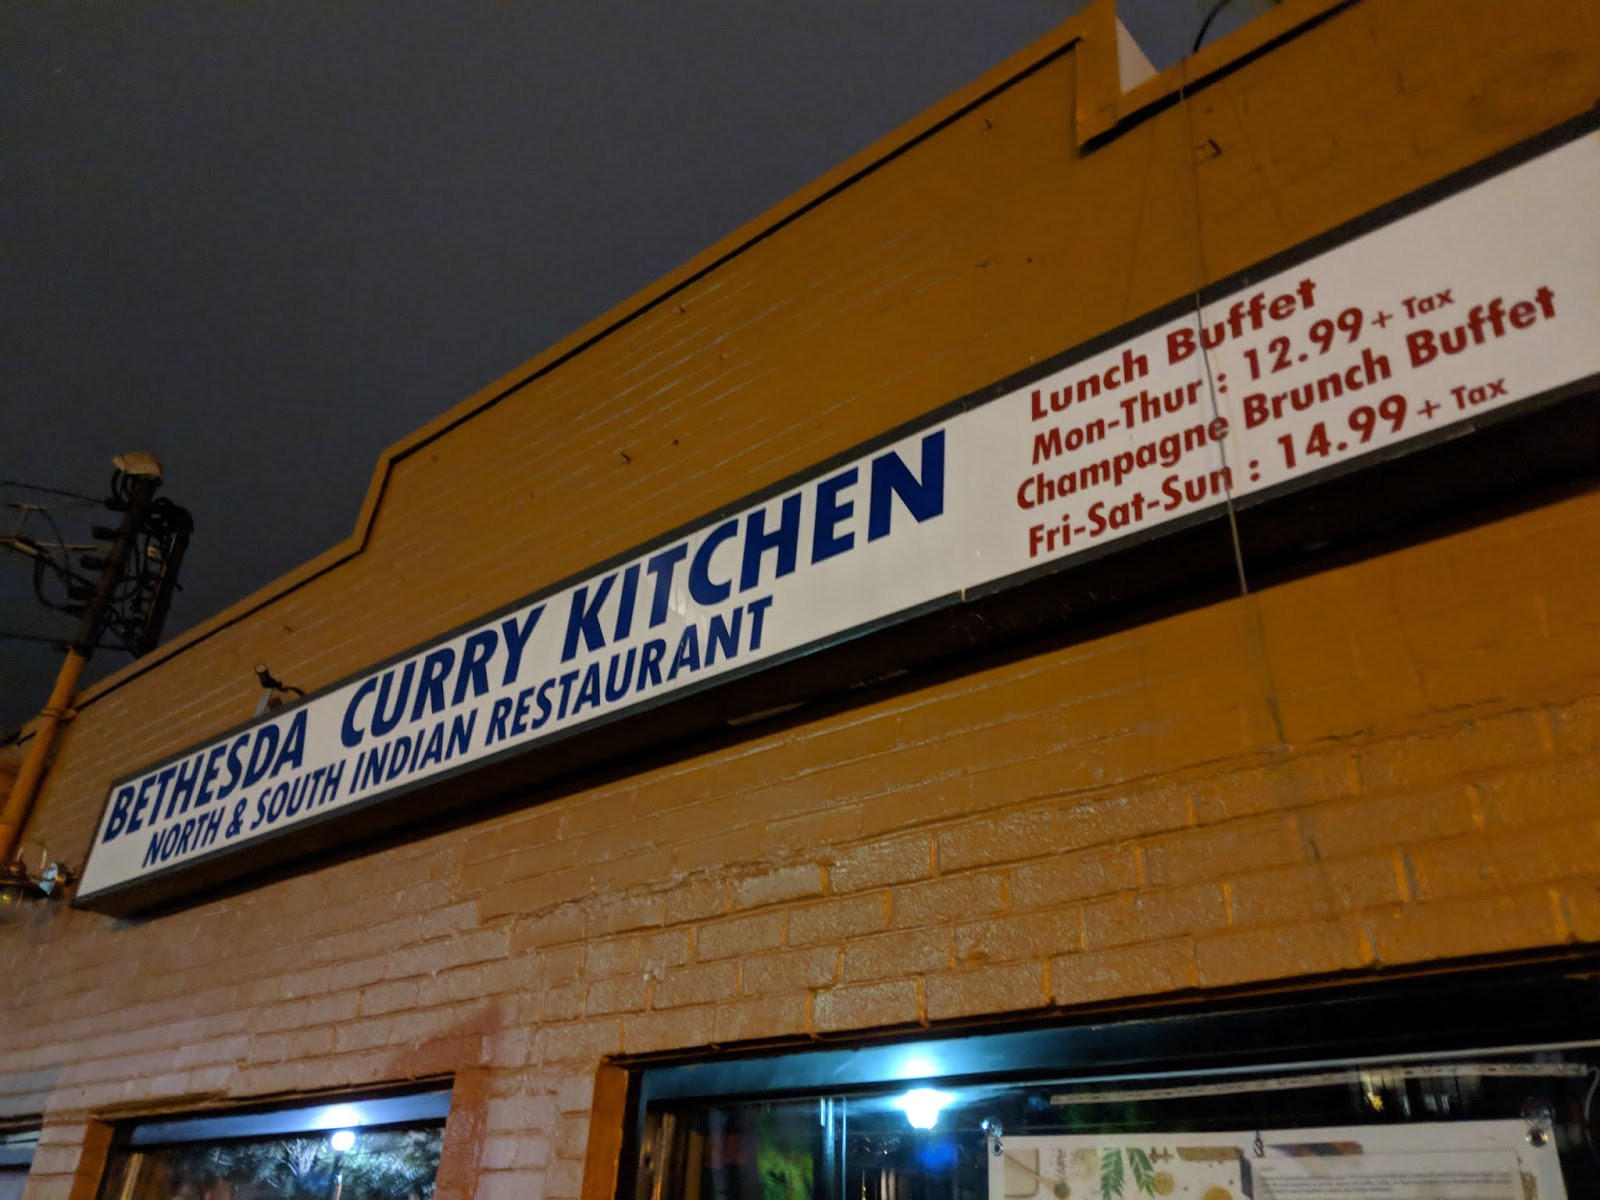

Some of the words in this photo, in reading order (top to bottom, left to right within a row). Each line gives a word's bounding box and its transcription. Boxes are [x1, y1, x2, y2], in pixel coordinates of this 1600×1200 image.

[1017, 416, 1228, 510] Champagne
[1243, 349, 1390, 429] Brunch
[1406, 286, 1556, 368] Buffet
[1030, 349, 1148, 421] Lunch
[1167, 278, 1316, 364] Buffet
[1032, 378, 1203, 464] Mon-Thur
[1243, 307, 1363, 381] 12.99
[1403, 286, 1455, 318] Tax
[1029, 466, 1233, 558] Fri-Sat-Sun
[1278, 394, 1407, 469] 14.99
[1450, 376, 1508, 411] Tax
[102, 709, 307, 843] BETHESDA
[341, 604, 546, 747] CURRY
[561, 429, 945, 663] KITCHEN
[142, 806, 225, 868] NORTH
[225, 797, 248, 837] &
[251, 760, 345, 829] SOUTH
[349, 708, 479, 795] INDIAN
[485, 596, 773, 746] RESTAURANT
